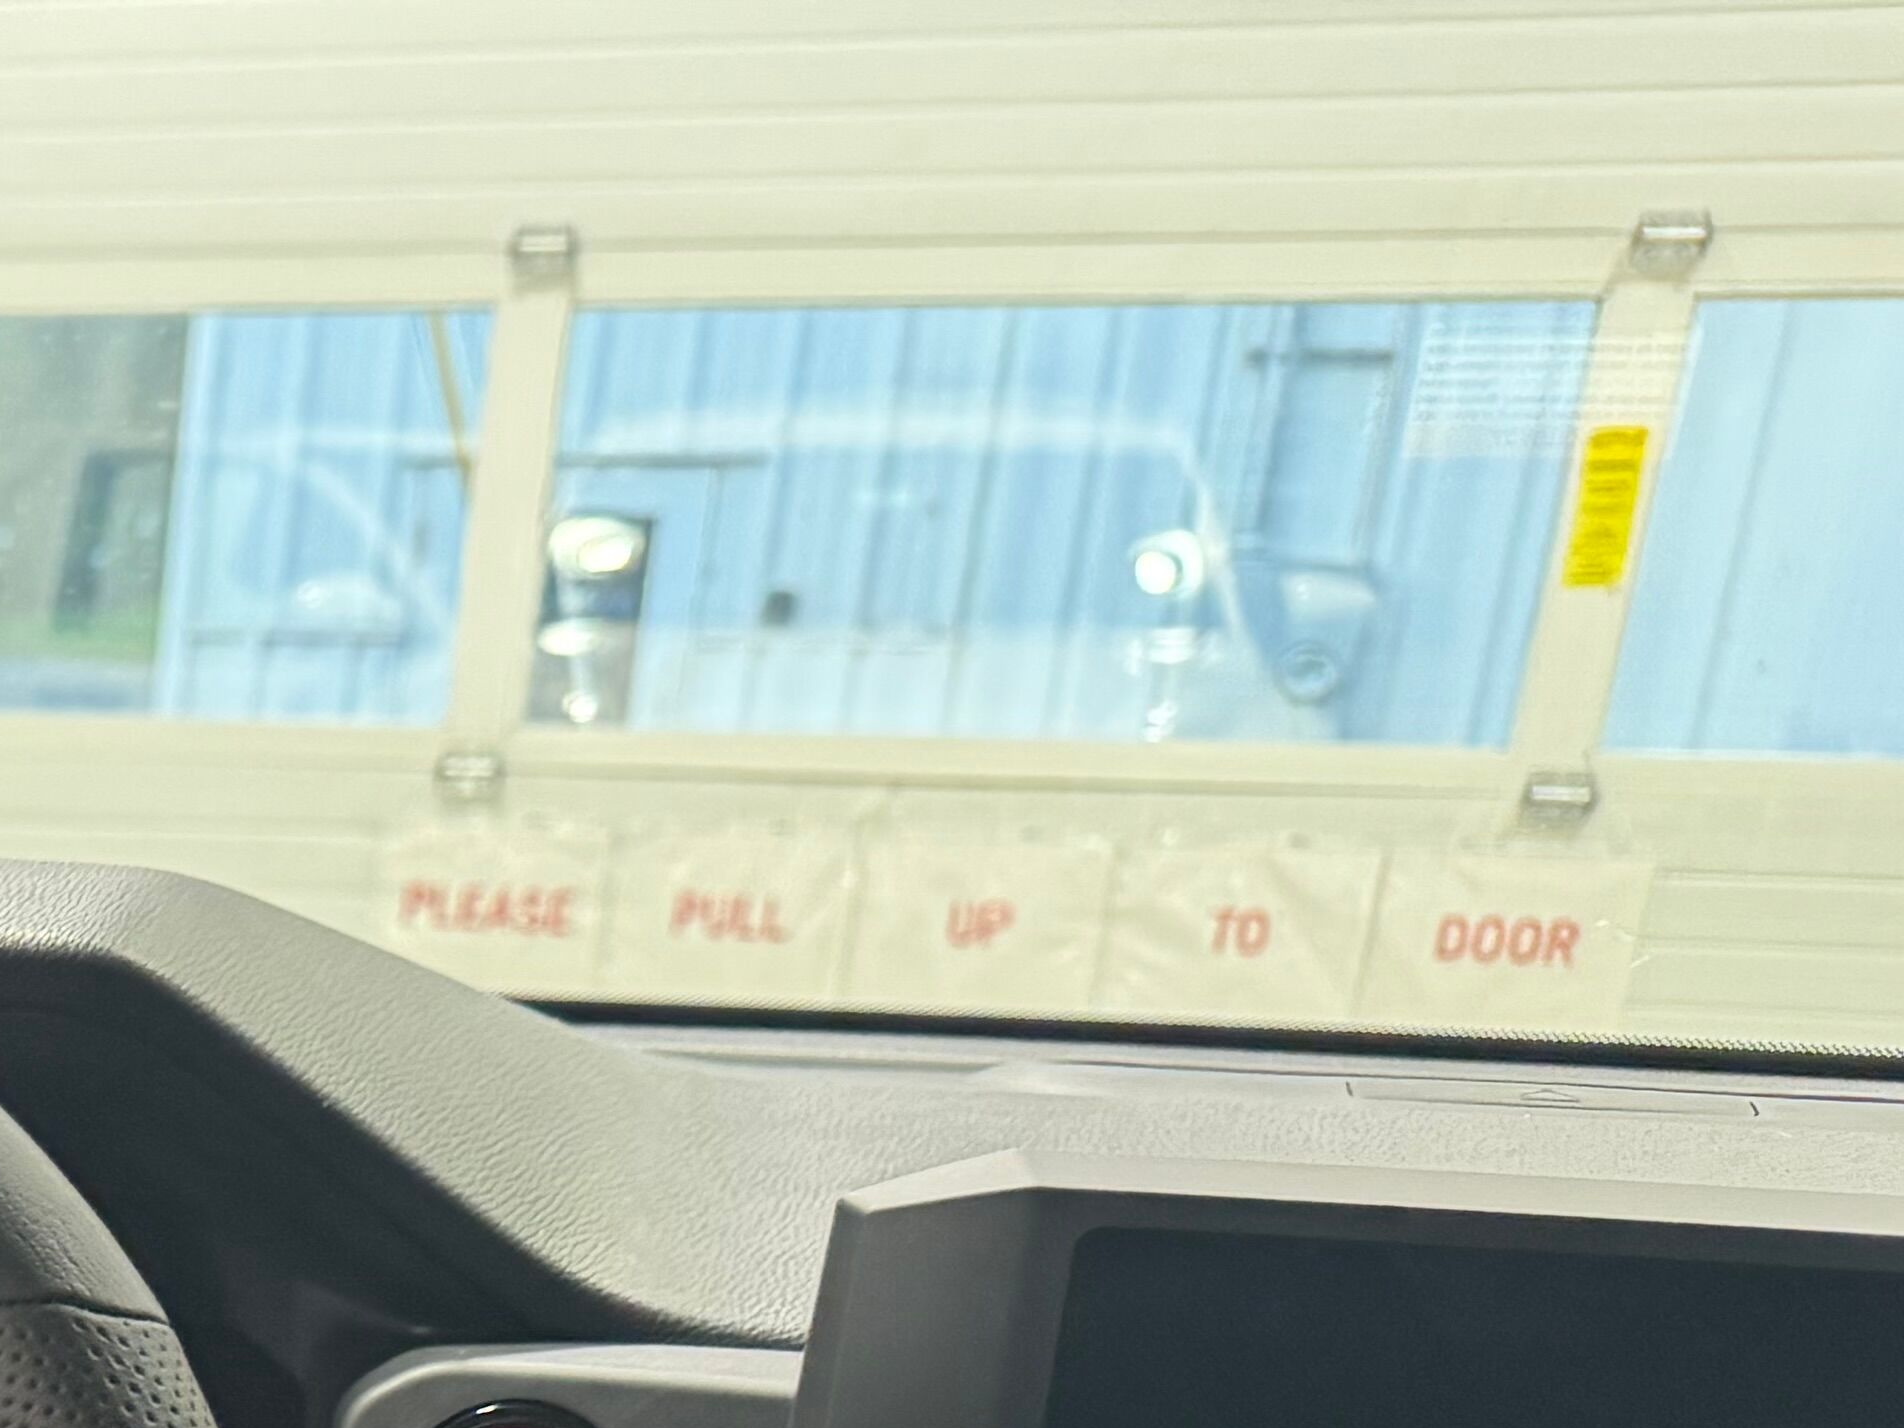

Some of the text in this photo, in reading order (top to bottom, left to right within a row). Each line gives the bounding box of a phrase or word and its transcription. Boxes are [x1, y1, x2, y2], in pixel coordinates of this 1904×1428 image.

[397, 880, 1581, 965] PLEASE PULL UP TO DOOR
